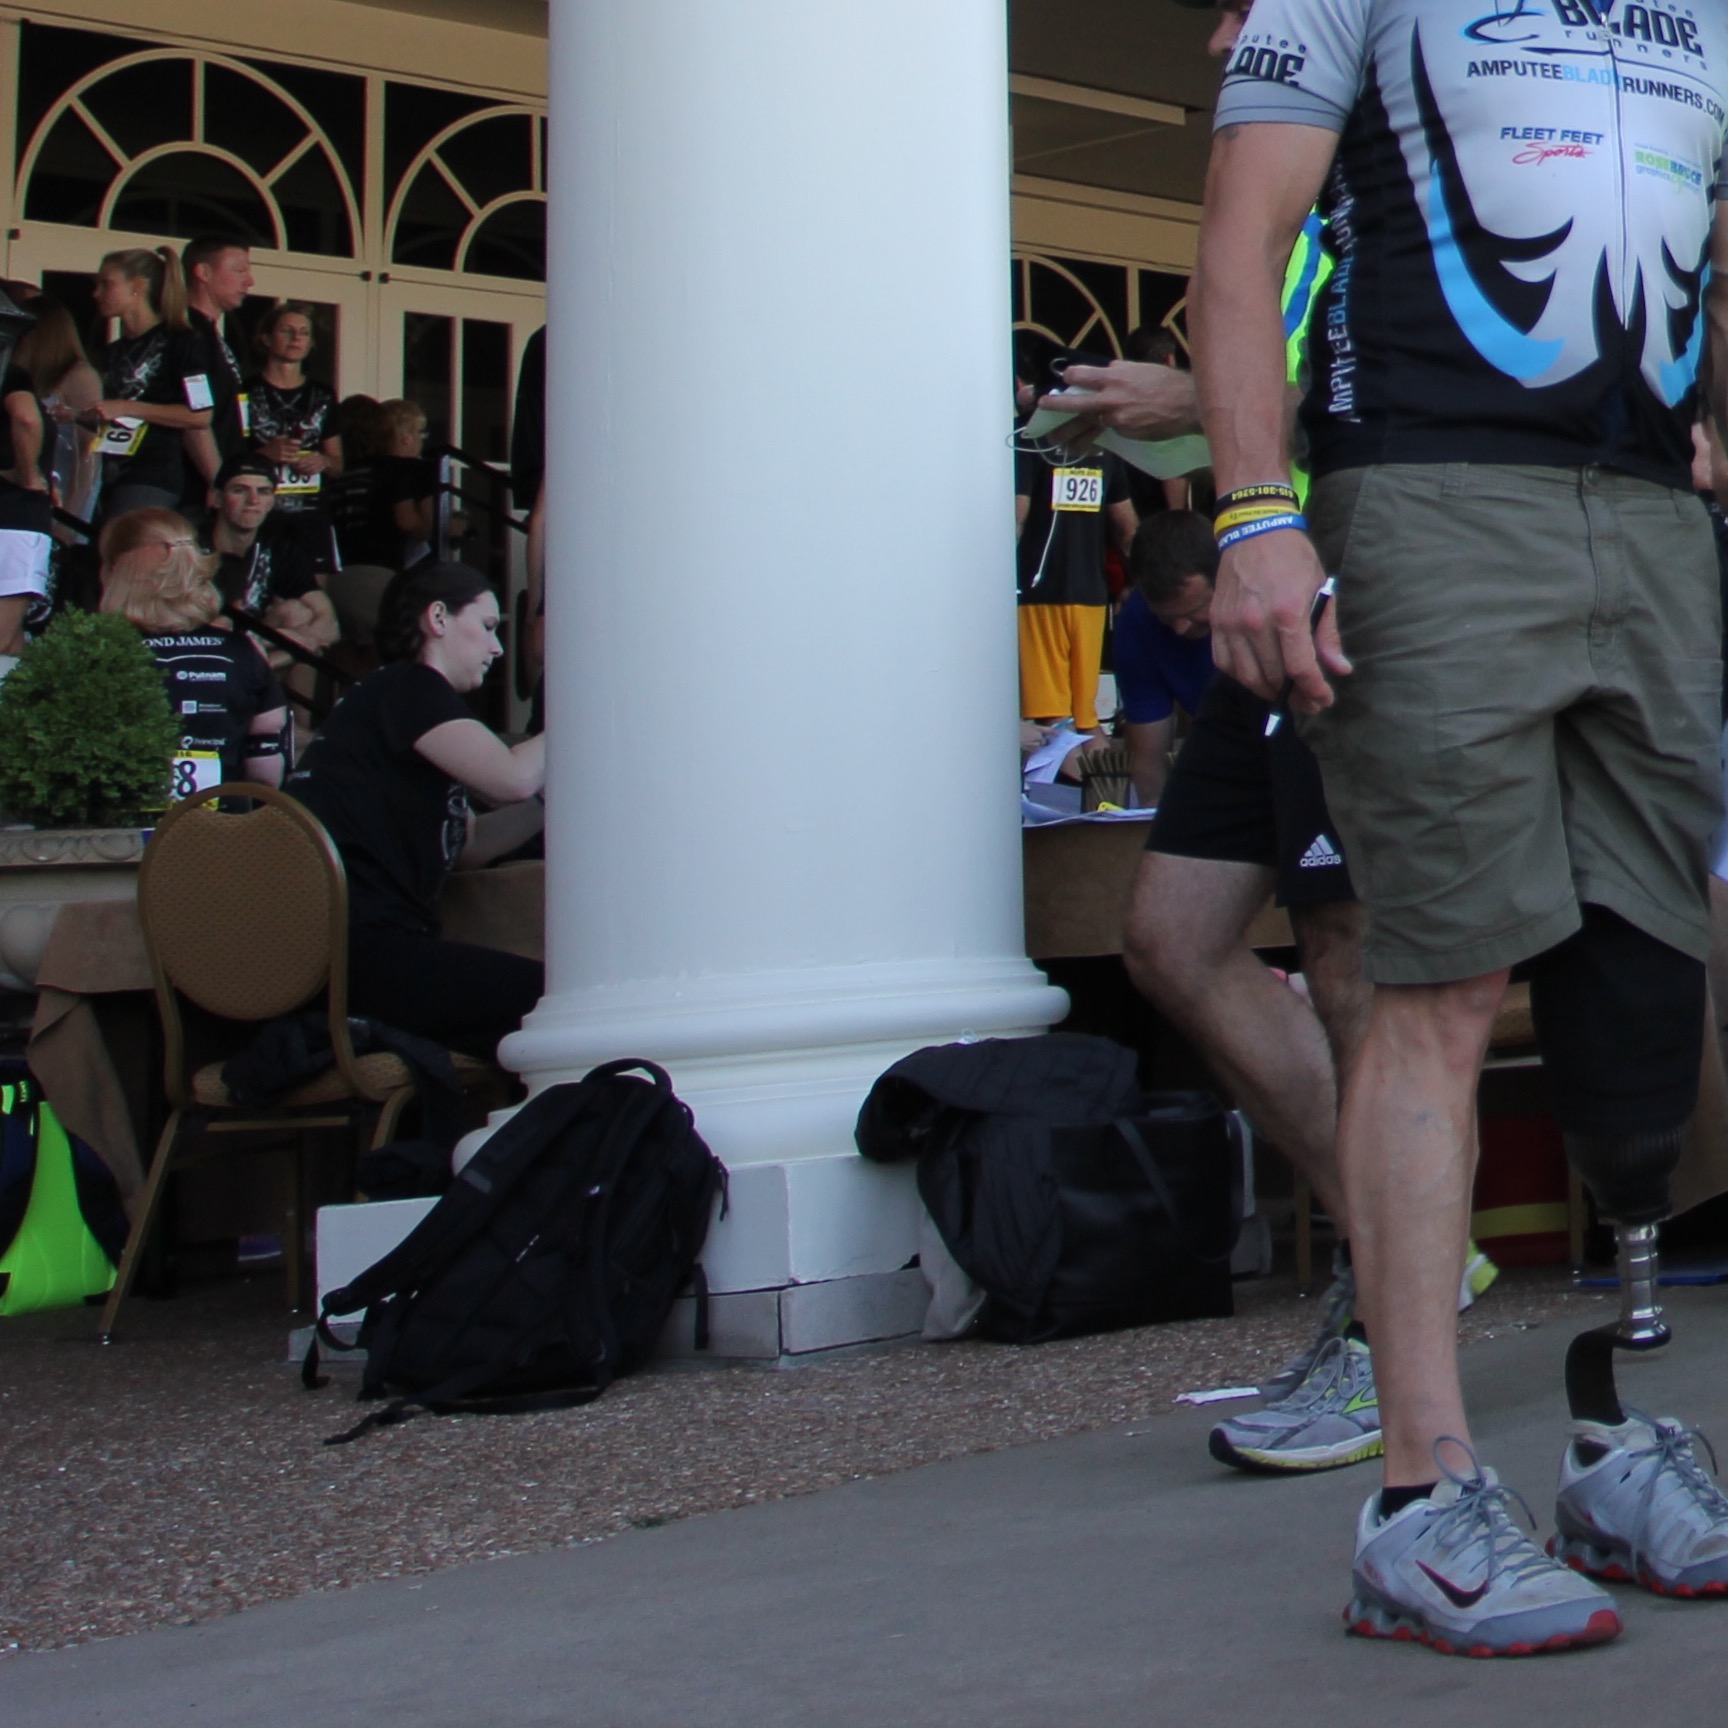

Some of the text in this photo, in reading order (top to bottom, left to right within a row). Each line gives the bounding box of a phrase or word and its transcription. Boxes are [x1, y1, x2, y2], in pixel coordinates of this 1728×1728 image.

[1500, 126, 1604, 145] FLEET FEET
[1511, 141, 1595, 167] Sports
[1066, 477, 1098, 502] 926
[1241, 515, 1294, 536] AMPUTEE
[176, 636, 223, 647] JAMES
[1300, 854, 1342, 867] adidas
